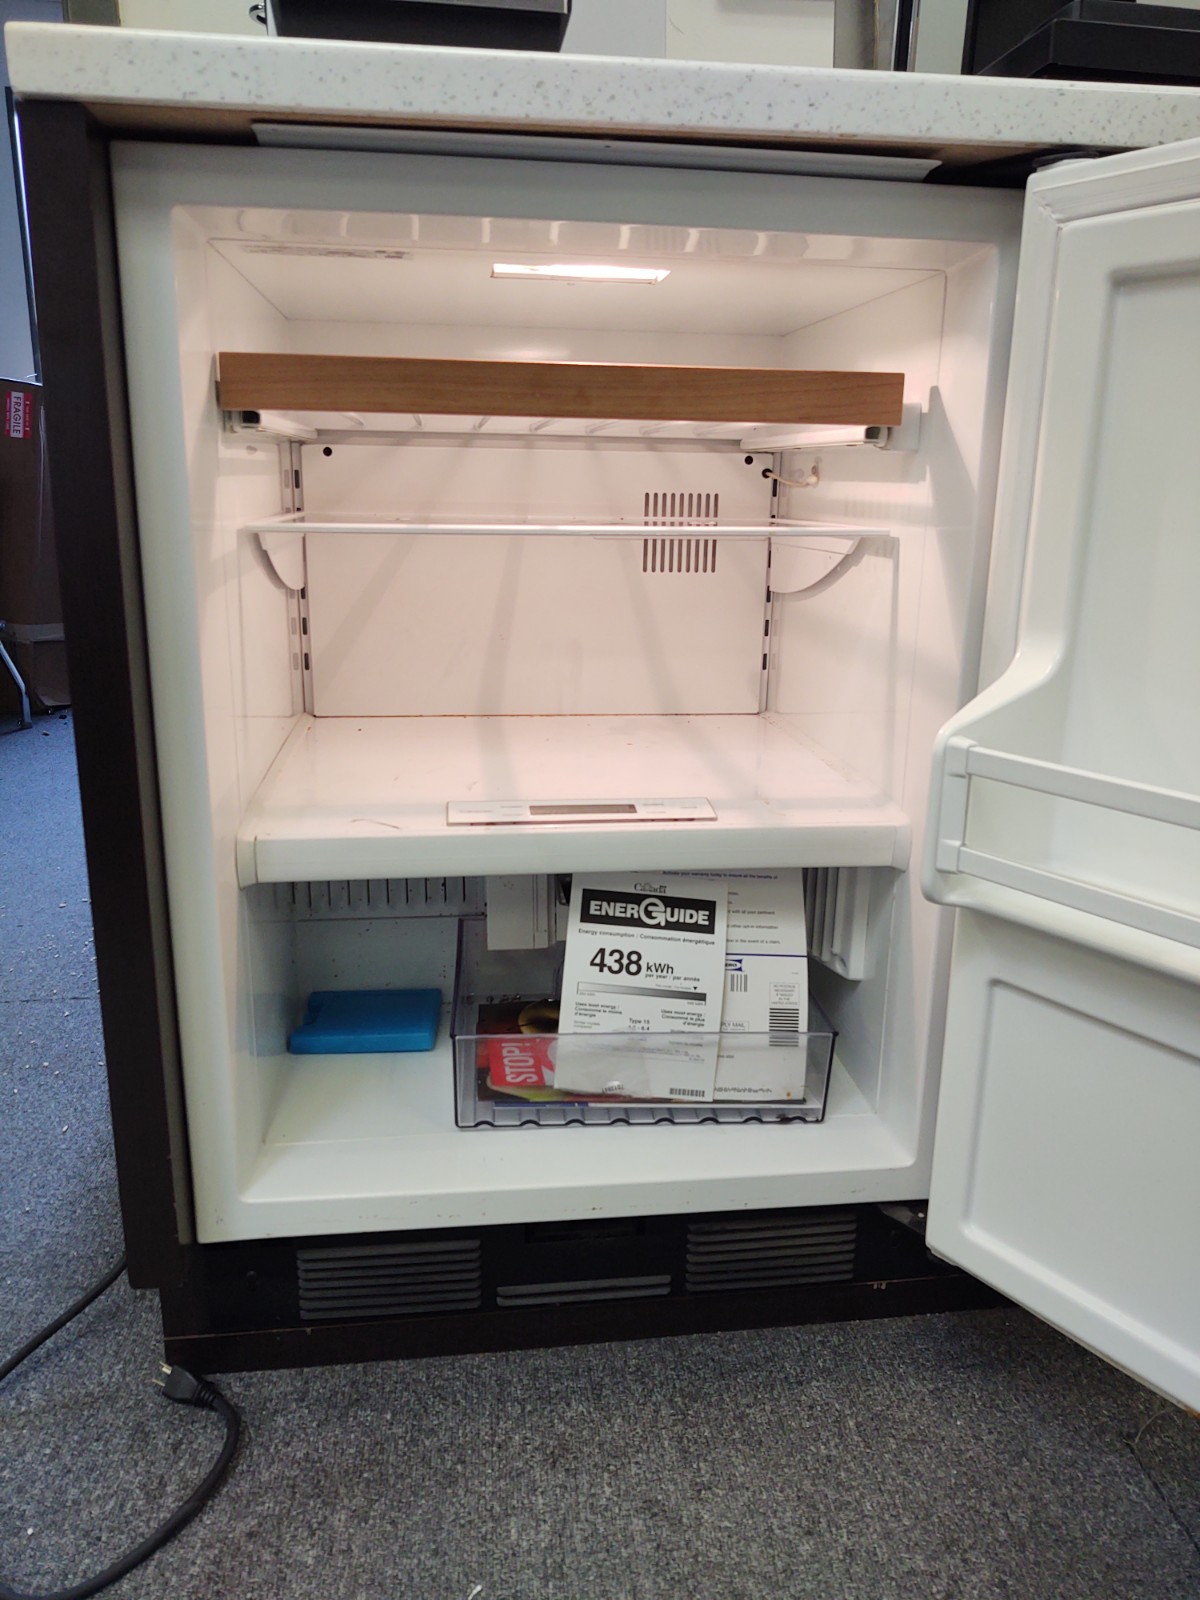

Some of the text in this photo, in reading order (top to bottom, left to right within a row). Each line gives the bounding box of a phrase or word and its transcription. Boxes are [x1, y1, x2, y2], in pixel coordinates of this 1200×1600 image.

[13, 396, 22, 435] FRAGILE
[634, 882, 667, 894] Canada
[589, 897, 709, 926] ENERGUIDE
[578, 928, 597, 936] Energy
[599, 930, 635, 938] consumption
[639, 933, 681, 941] Consommation
[589, 948, 674, 976] 438 kWh
[629, 1017, 642, 1025] Type
[501, 1042, 538, 1083] STOP!
